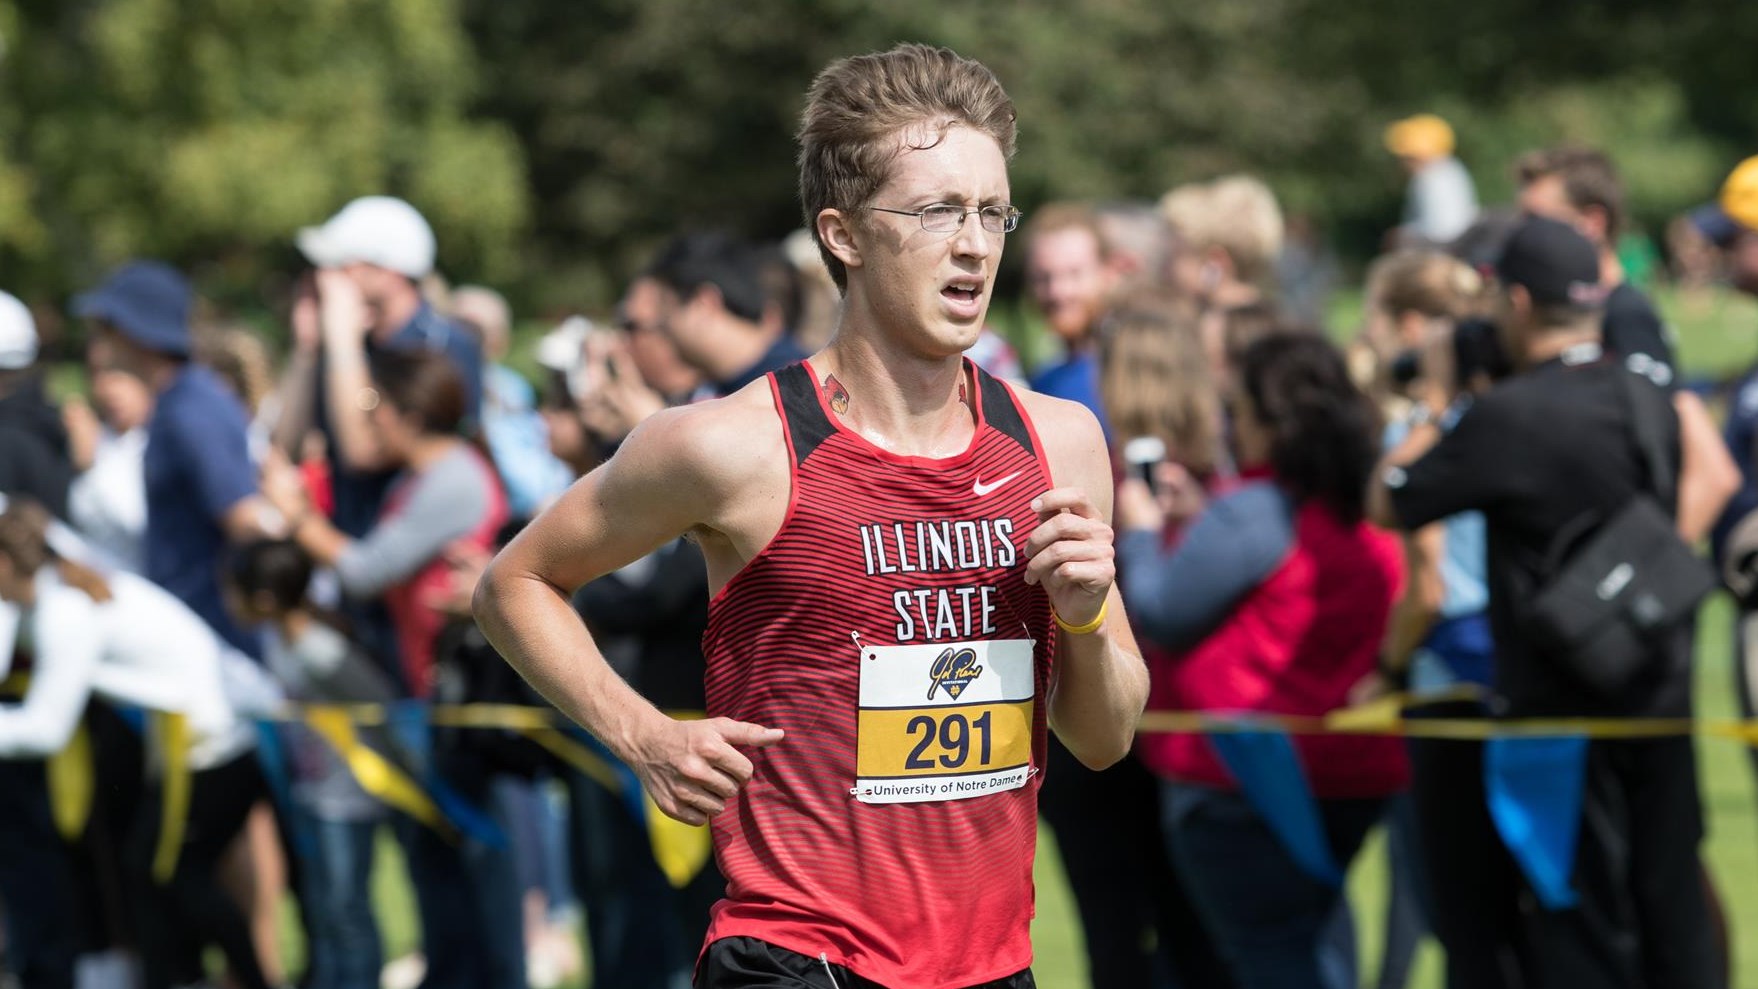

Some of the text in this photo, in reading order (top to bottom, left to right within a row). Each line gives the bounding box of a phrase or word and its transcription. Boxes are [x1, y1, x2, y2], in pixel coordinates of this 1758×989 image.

[860, 518, 1016, 576] ILLINOIS
[893, 585, 997, 641] STATE
[904, 711, 991, 770] 291
[874, 775, 1016, 796] University of Notre Dame
